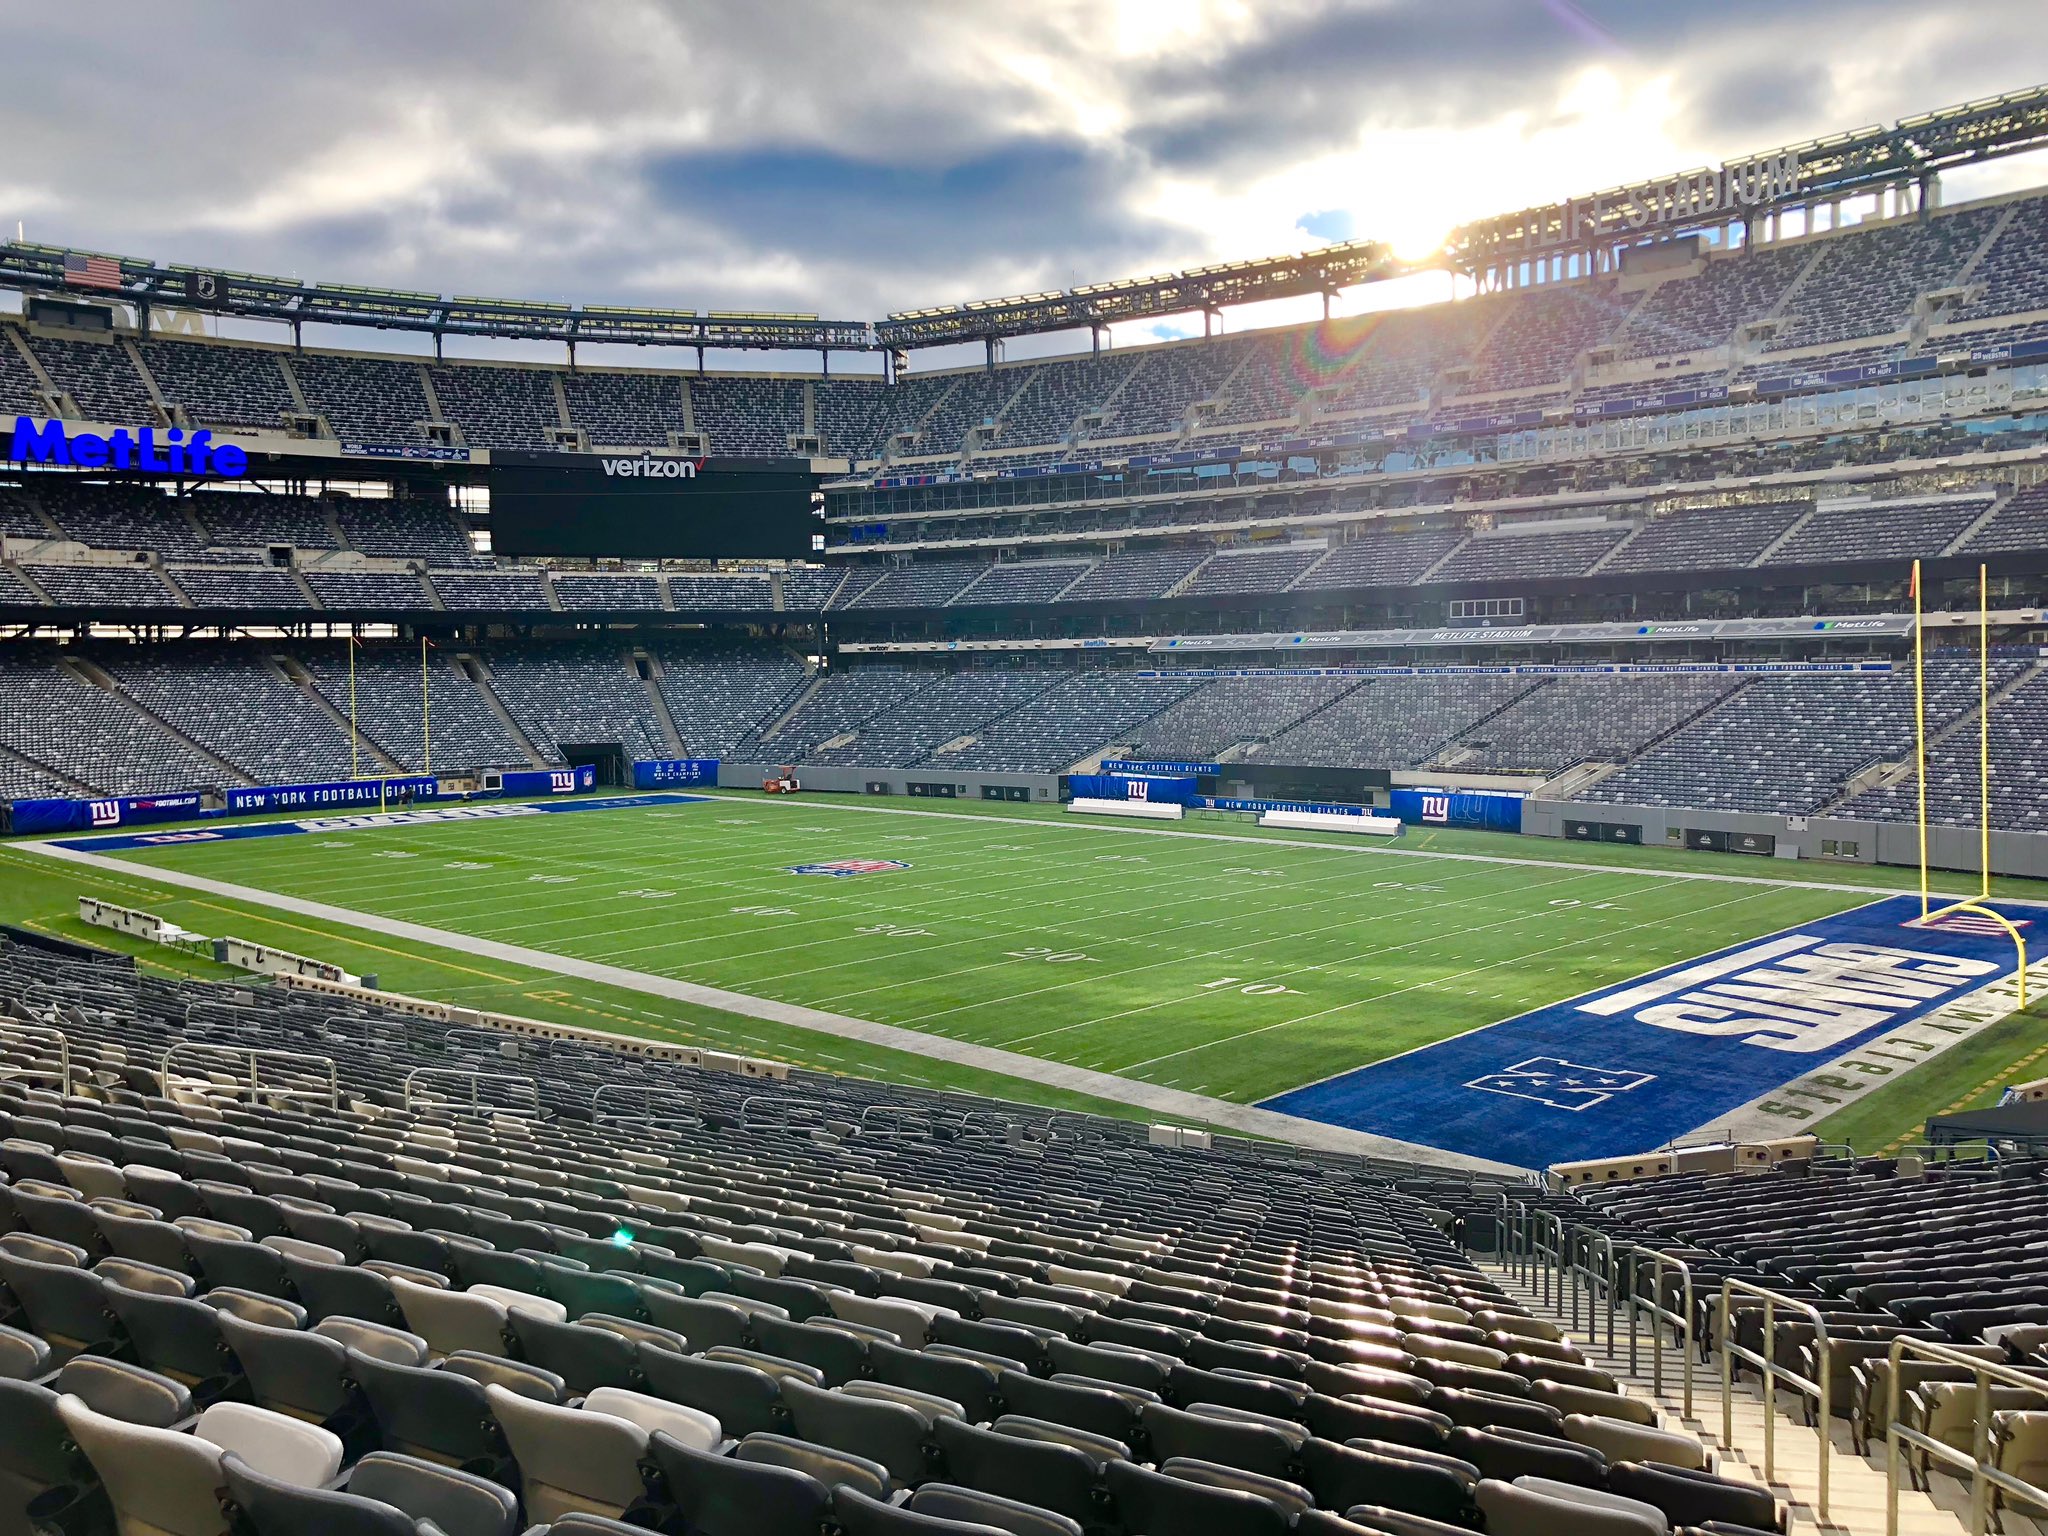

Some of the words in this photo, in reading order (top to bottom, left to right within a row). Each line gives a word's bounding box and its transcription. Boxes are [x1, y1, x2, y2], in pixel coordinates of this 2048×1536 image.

[1628, 152, 1800, 228] STADIUM
[11, 416, 249, 477] MetLife
[601, 455, 696, 478] verizon
[1834, 620, 1886, 628] MetLife
[1431, 631, 1480, 640] METLIFE
[1480, 630, 1534, 639] STADIUM
[1147, 764, 1181, 772] FOOTBALL
[1185, 765, 1212, 773] GIANTS
[551, 772, 575, 792] ny
[1127, 780, 1149, 802] ny
[236, 794, 266, 808] NEW
[273, 790, 307, 805] YORK
[314, 786, 379, 802] FOOTBALL
[1226, 800, 1243, 808] NEW
[1248, 801, 1268, 810] YORK
[1272, 804, 1312, 813] FOOTBALL
[1317, 806, 1348, 815] GIANTS
[90, 800, 120, 825] ny
[1422, 796, 1449, 822] ny
[854, 923, 926, 937] 30
[1002, 946, 1087, 963] 20
[1194, 976, 1287, 995] 10
[1633, 942, 2000, 1053] GIANTS
